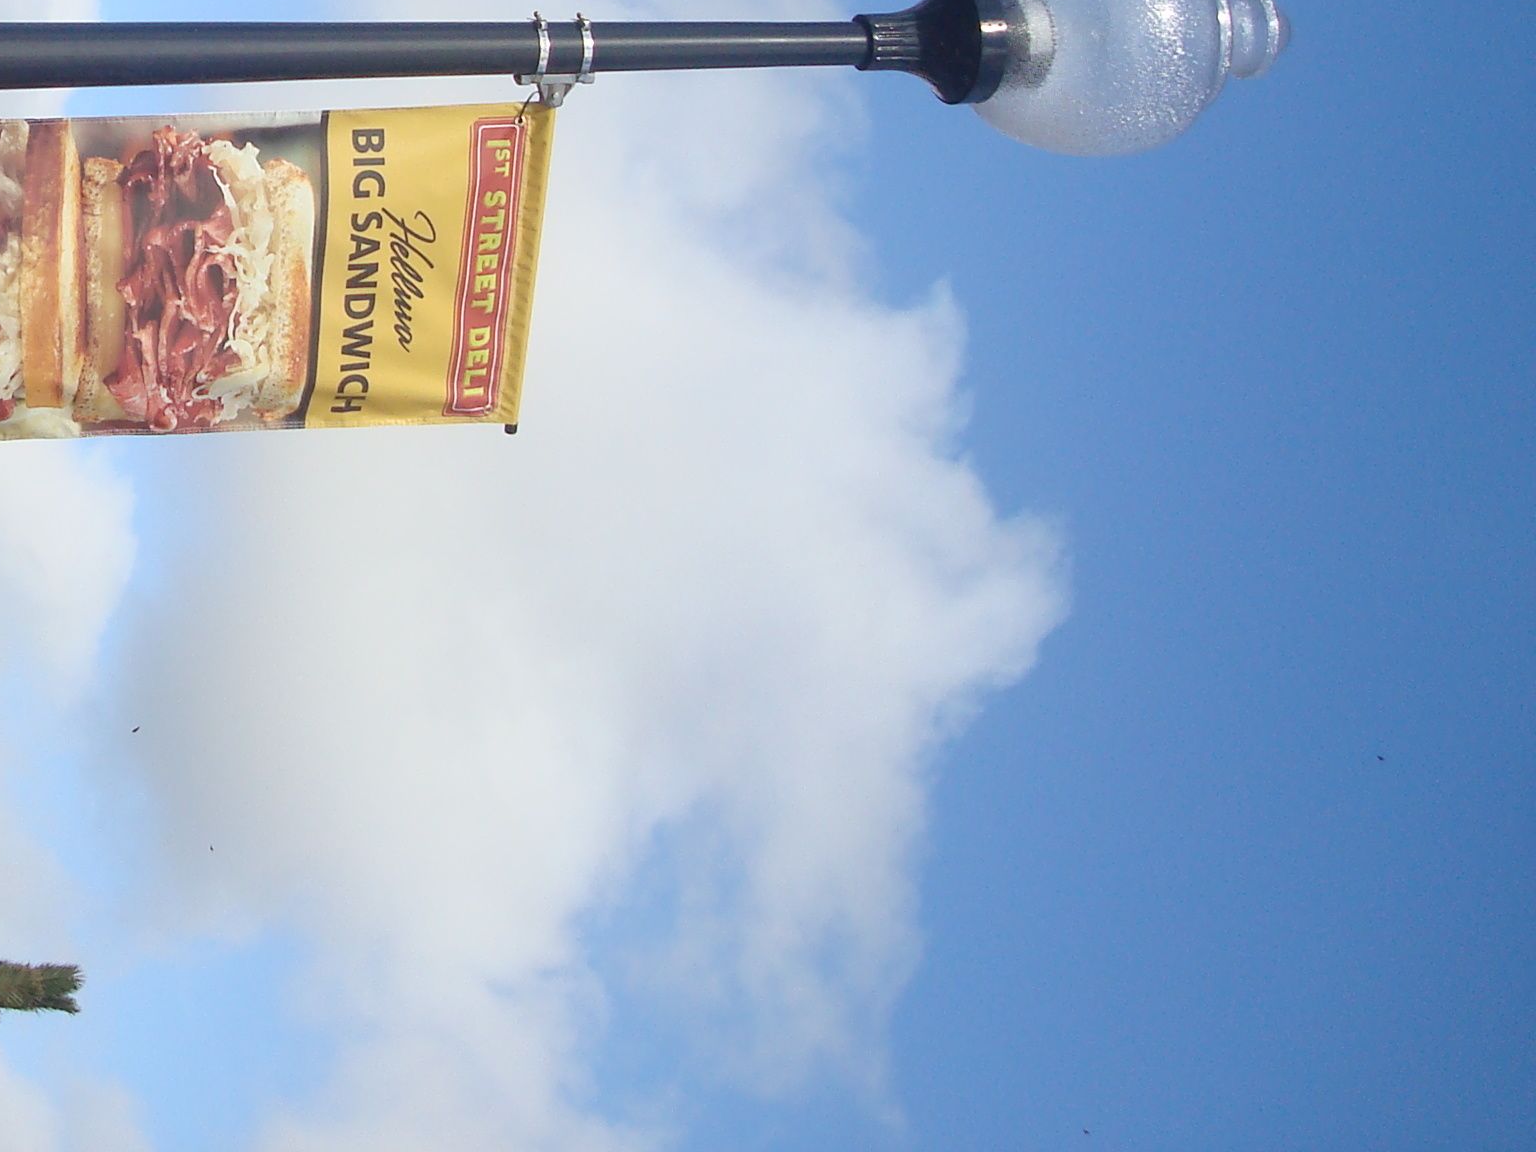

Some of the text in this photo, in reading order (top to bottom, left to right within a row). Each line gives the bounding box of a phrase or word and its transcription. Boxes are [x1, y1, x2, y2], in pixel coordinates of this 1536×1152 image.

[330, 128, 386, 414] BIG SANDWICH
[381, 208, 436, 352] Helluva
[470, 191, 506, 314] STREET
[462, 326, 491, 397] DELI
